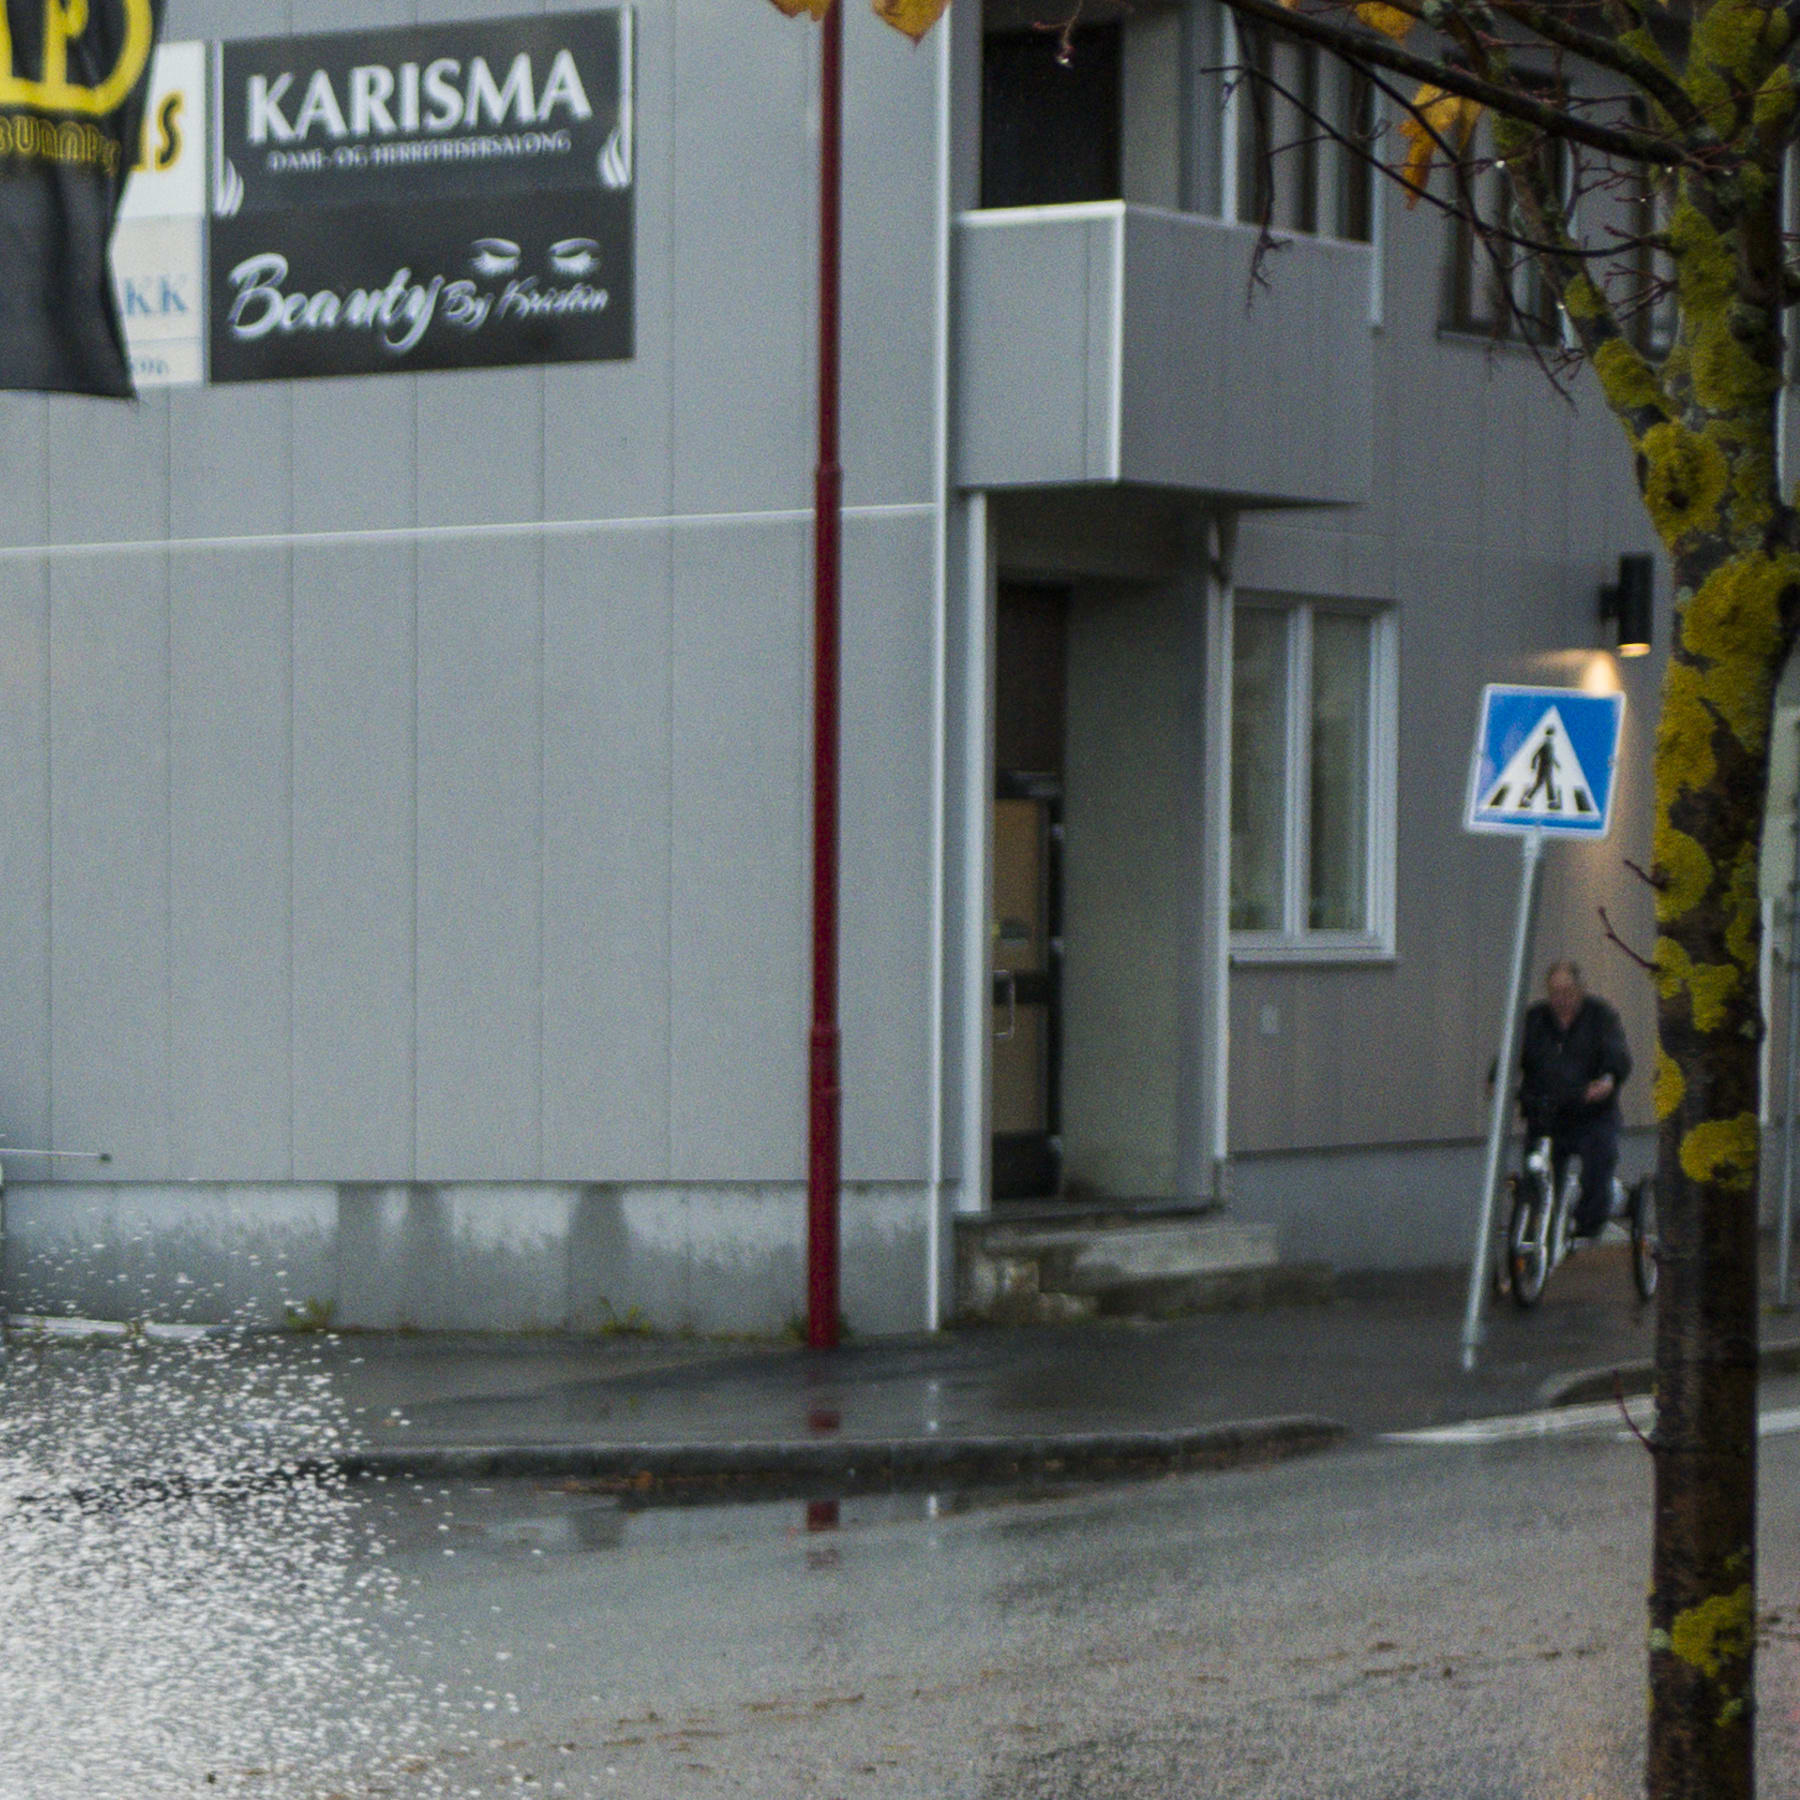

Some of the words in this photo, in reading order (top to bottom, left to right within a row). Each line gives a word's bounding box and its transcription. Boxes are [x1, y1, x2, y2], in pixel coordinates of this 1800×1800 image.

[246, 49, 593, 146] KARISMA
[227, 252, 444, 354] Beauty
[442, 278, 495, 330] By
